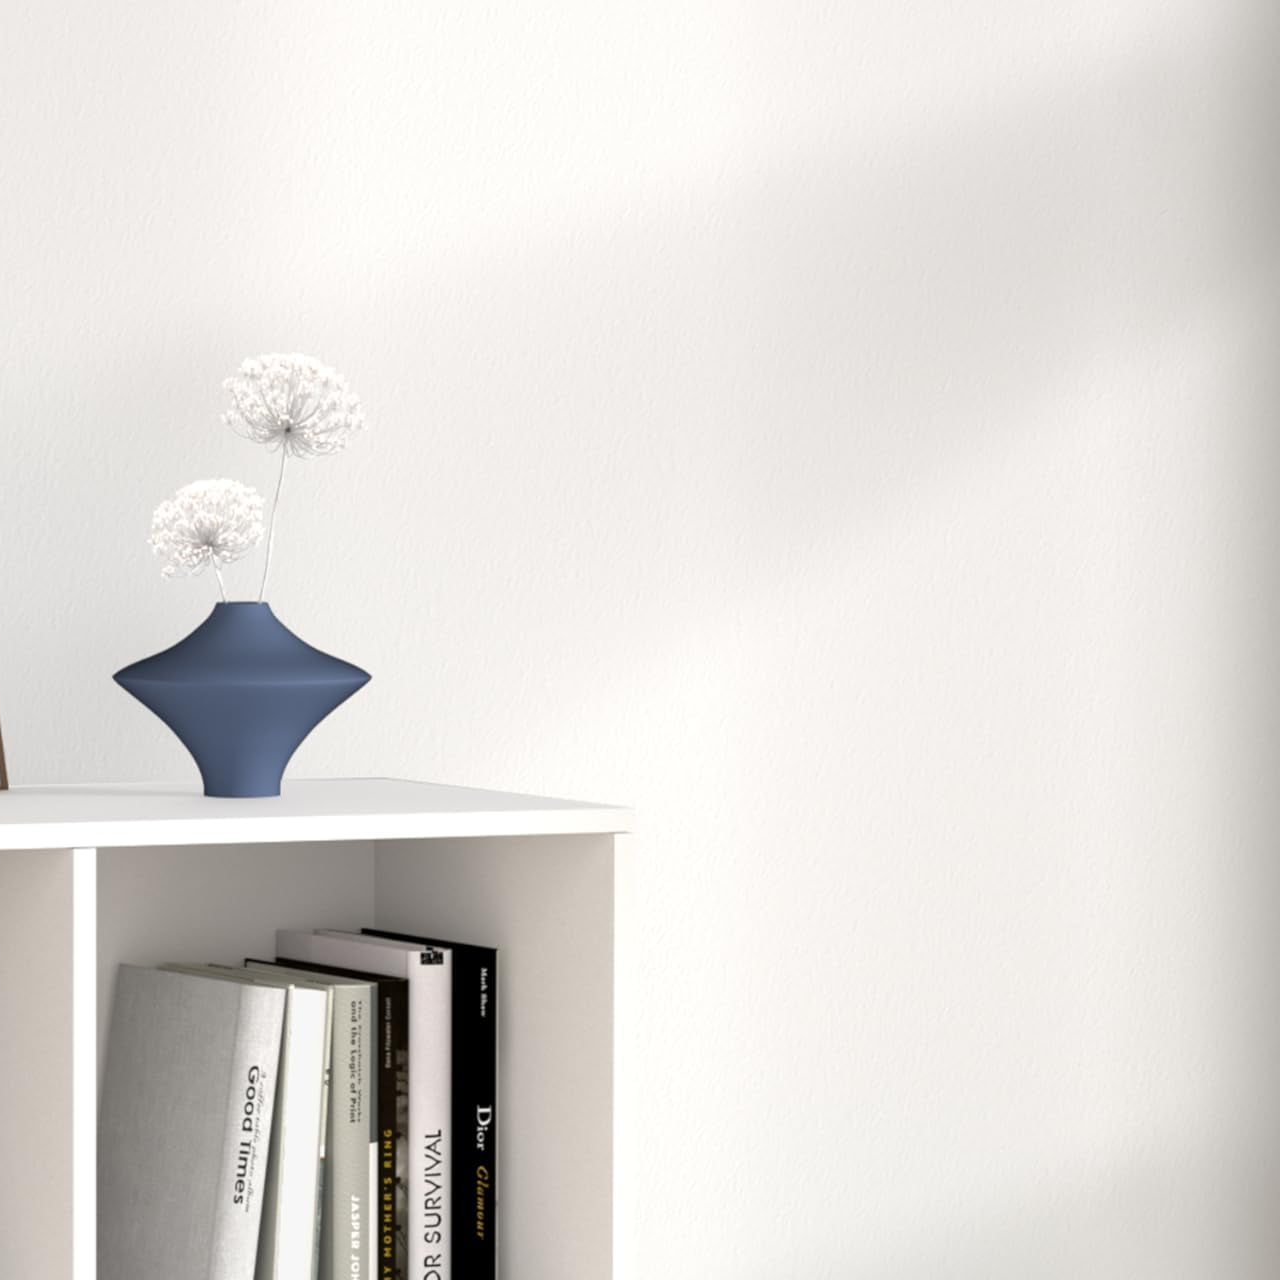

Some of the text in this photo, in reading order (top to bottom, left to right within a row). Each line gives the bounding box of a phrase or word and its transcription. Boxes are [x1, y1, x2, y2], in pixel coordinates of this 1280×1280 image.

[349, 1097, 357, 1124] Print
[350, 1082, 357, 1094] of
[233, 1065, 260, 1205] Good Times
[383, 1129, 393, 1168] RING
[423, 1129, 442, 1244] SURVIVAL
[475, 1104, 492, 1240] Dior Glamour
[351, 1195, 360, 1249] JASPER
[383, 1177, 393, 1258] MOTHER'S
